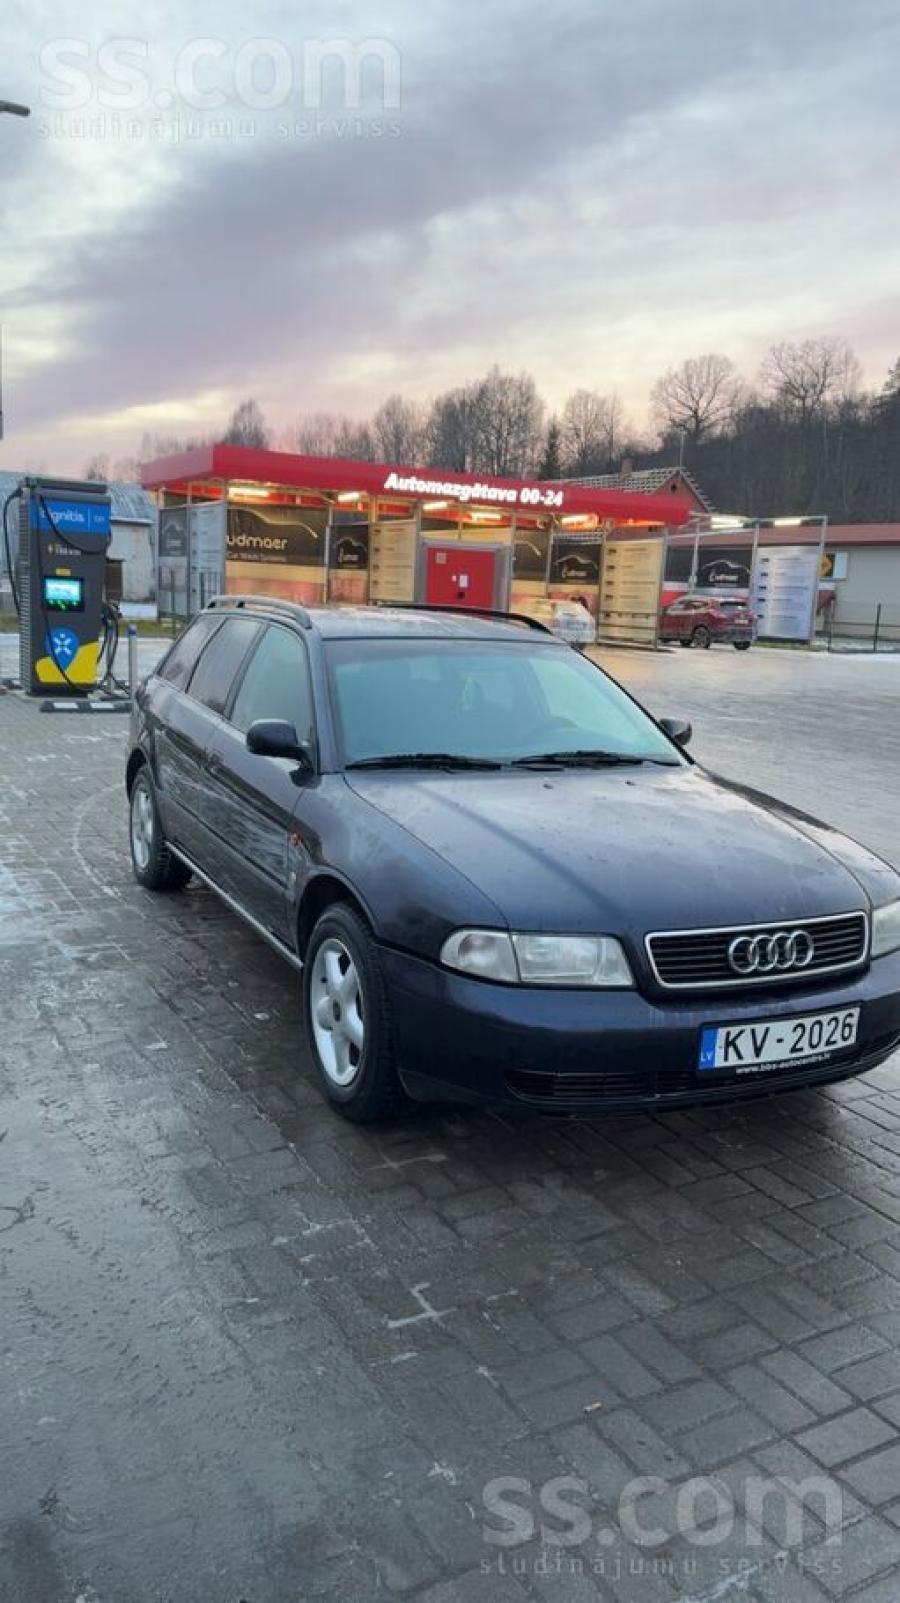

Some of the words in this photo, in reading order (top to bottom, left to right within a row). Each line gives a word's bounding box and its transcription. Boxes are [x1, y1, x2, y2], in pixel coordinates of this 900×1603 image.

[384, 472, 517, 501] Automazgātava
[520, 488, 563, 507] 00-24
[724, 1012, 854, 1062] KV-2026
